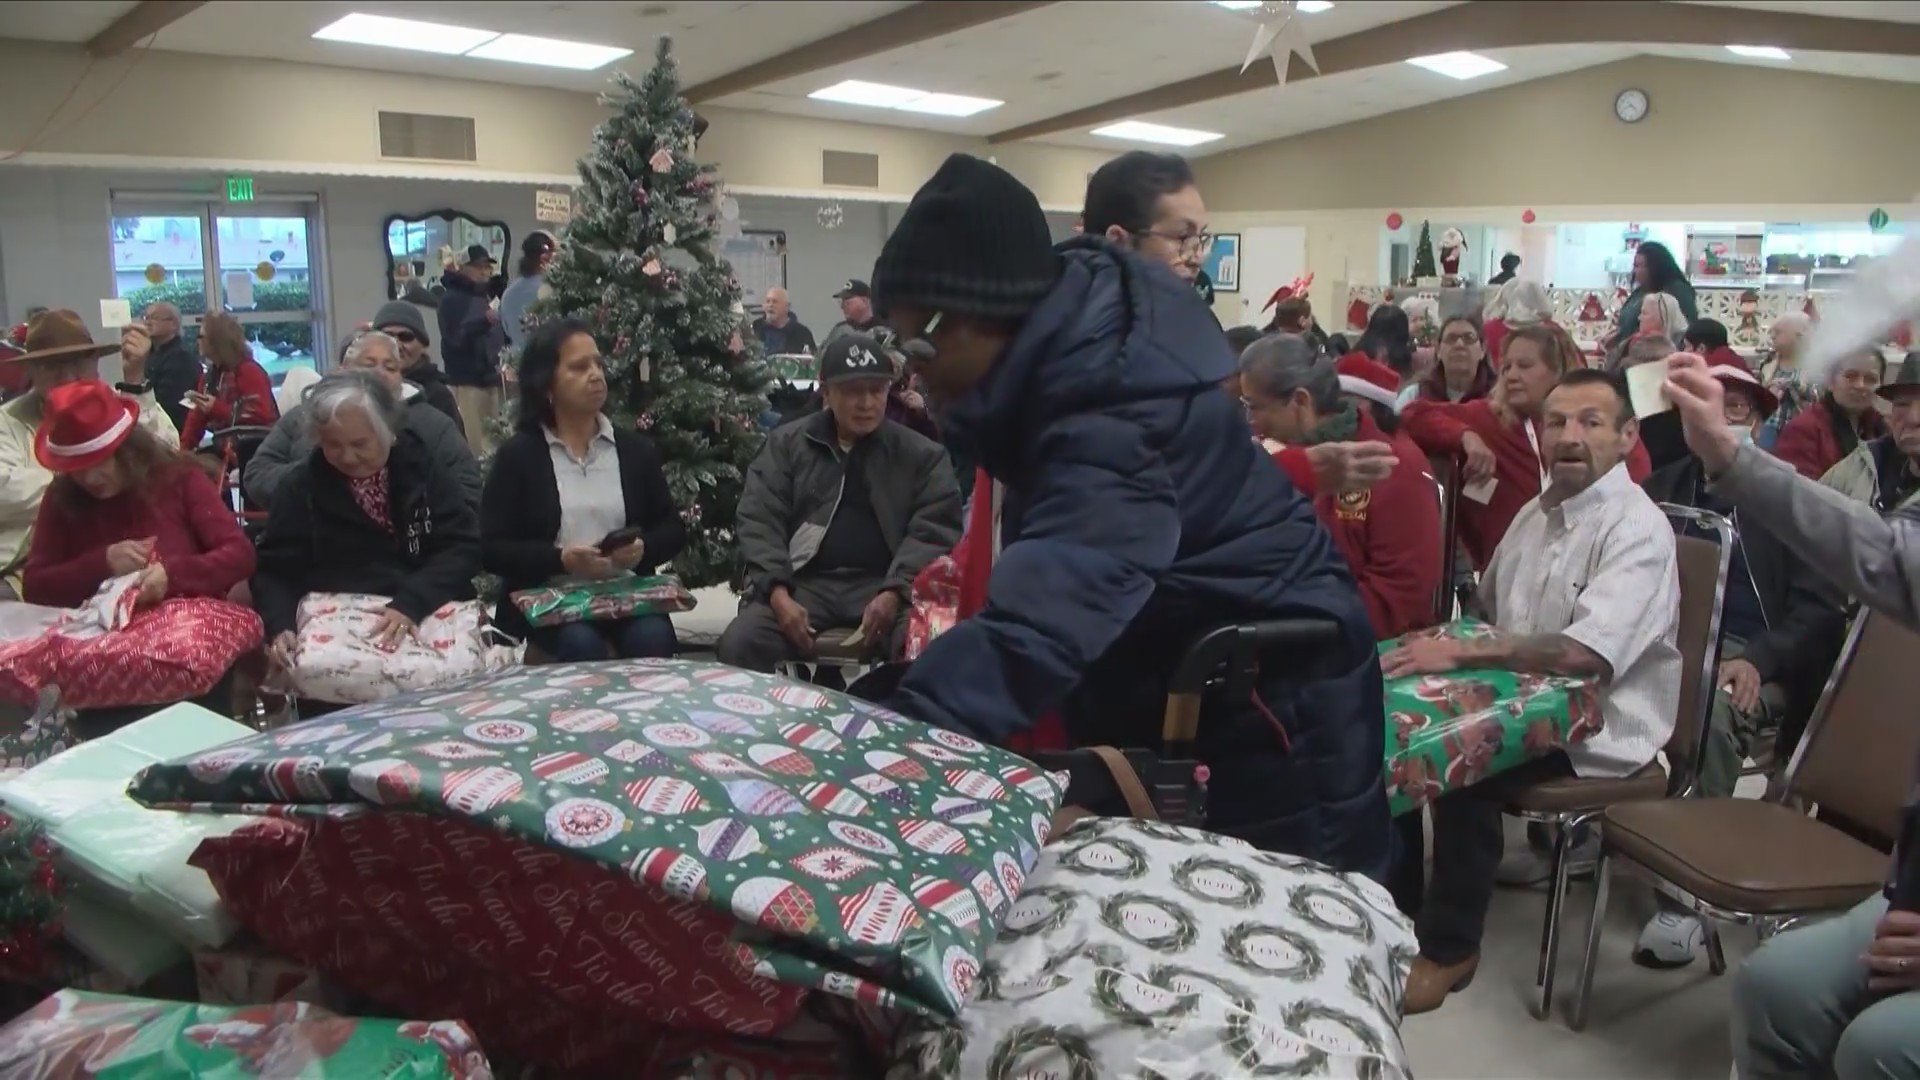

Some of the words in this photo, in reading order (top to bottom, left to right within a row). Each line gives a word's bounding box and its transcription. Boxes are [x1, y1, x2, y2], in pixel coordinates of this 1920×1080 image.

[227, 177, 254, 201] EXIT
[1089, 850, 1115, 865] JOY
[602, 910, 677, 988] Season
